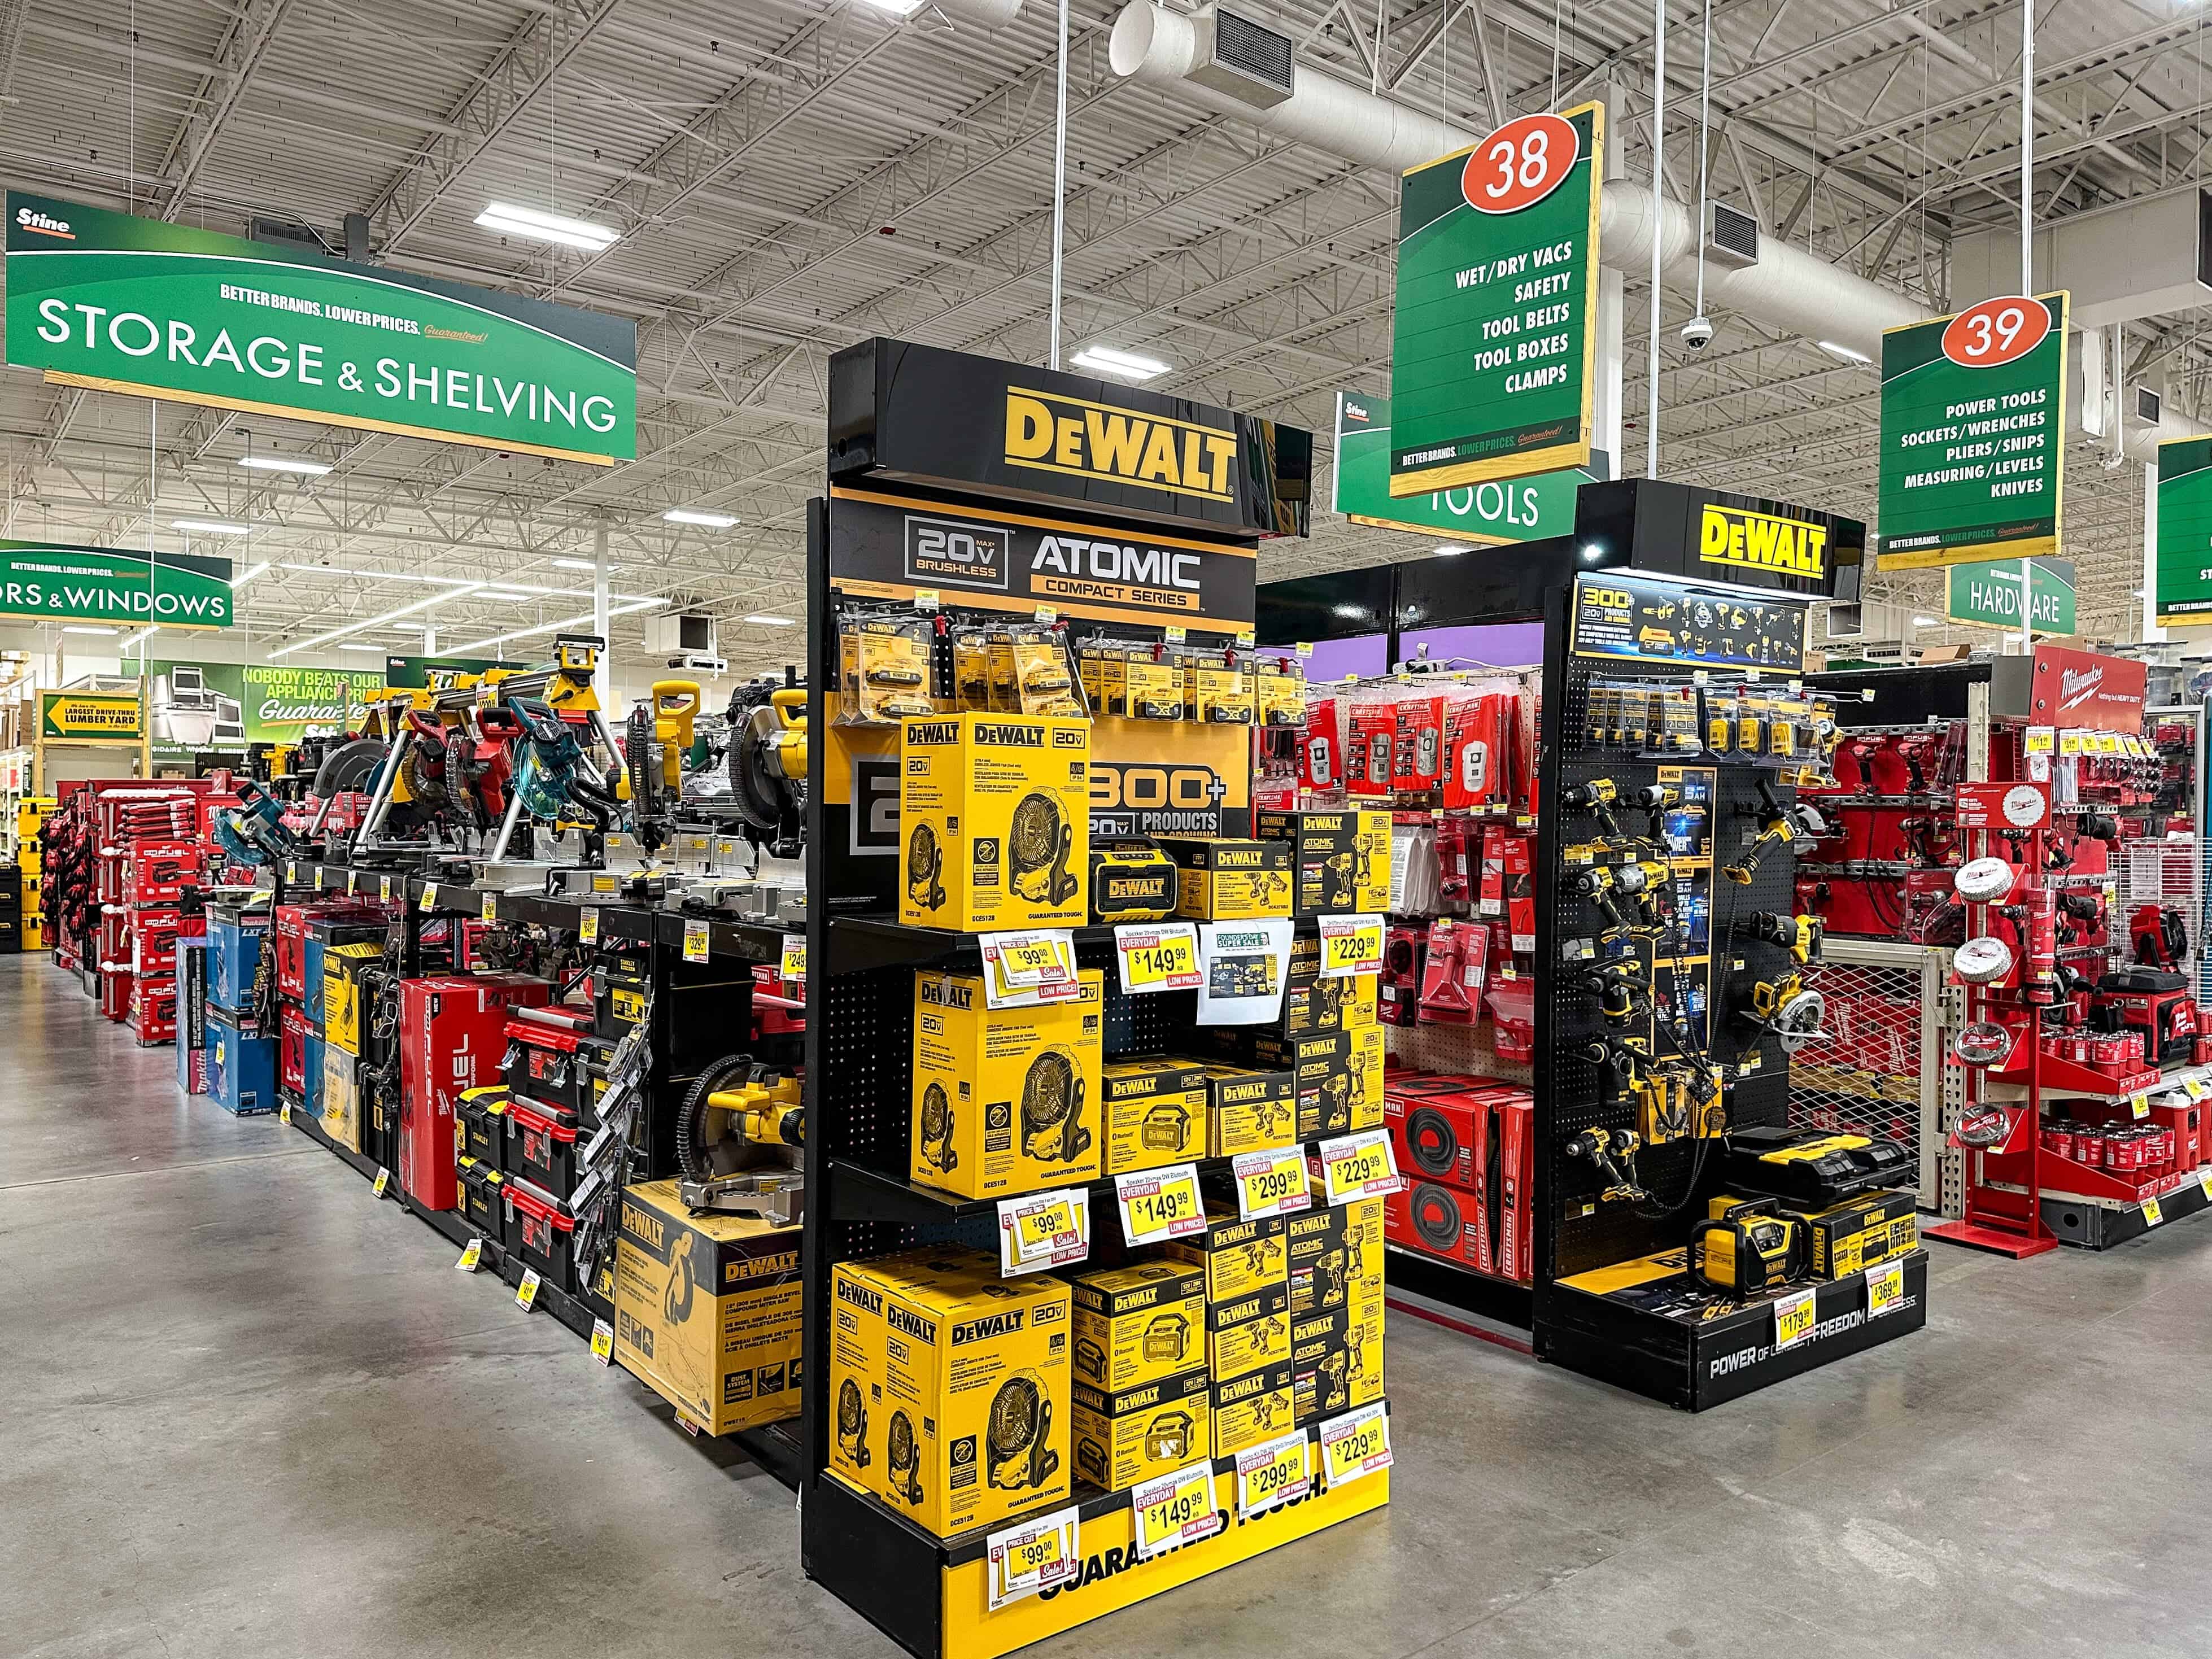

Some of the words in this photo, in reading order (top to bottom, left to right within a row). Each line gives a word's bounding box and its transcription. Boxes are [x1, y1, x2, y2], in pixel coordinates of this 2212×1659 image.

[1485, 129, 1549, 198] 38
[16, 207, 71, 233] Stine
[1456, 251, 1529, 289] WET/DRY
[1533, 241, 1572, 267] VACS
[1515, 272, 1571, 303] SAFETY
[1482, 317, 1521, 340] TOOL
[1525, 303, 1570, 329] BELTS
[1965, 308, 2024, 356] 39
[1473, 348, 1513, 371] TOOL
[1516, 334, 1569, 361] BOXES
[37, 298, 324, 387] STORAGE
[338, 363, 364, 392] &
[374, 357, 617, 433] SHELVING
[1505, 364, 1567, 394] CLAMPS
[1345, 401, 1368, 417] Stine
[1945, 399, 1996, 420] POWER
[2001, 389, 2046, 411] TOOLS
[1901, 412, 2045, 448] SOCKETS/WRENCHES
[1946, 434, 2044, 461] PLIERS/SNIPS
[1904, 456, 2044, 488] MEASURING/LEVELS
[1991, 478, 2043, 498] KNIVES
[917, 560, 997, 577] BRUSHLESS
[1031, 536, 1201, 588] ATOMIC
[0, 582, 42, 606] RS
[49, 593, 63, 608] &
[63, 586, 225, 617] WINDOWS
[1045, 579, 1126, 600] COMPACT
[1132, 588, 1187, 606] SERIES
[1604, 608, 1630, 617] PRODUCTS
[1174, 655, 1181, 663] 5
[243, 669, 302, 686] NOBODY
[305, 672, 350, 686] BEATS
[353, 674, 380, 688] OUR
[2061, 664, 2104, 700] Milwaukee
[266, 684, 337, 700] APPLIANC
[1142, 813, 1217, 830] PRODUCTS
[1324, 927, 1354, 936] EVERYDAY
[1120, 937, 1158, 948] EVERYDAY
[1044, 967, 1063, 977] Sale!
[1168, 976, 1184, 985] LOW
[1185, 974, 1202, 983] PRICE!
[1040, 986, 1055, 995] LOW
[1057, 984, 1077, 993] PRICE!
[1300, 1062, 1329, 1072] ATOMIC
[1325, 1148, 1355, 1161] EVERYDAY
[1041, 1168, 1076, 1178] GUARANTEED
[1238, 1163, 1271, 1176] EVERYDAY
[1122, 1184, 1159, 1198] EVERYDAY
[1171, 1223, 1184, 1233] LOW
[1184, 1219, 1204, 1230] PRICE!
[1057, 1233, 1076, 1245] Sale!
[763, 1294, 783, 1302] SINGLE
[1711, 1346, 1756, 1379] POWER
[1758, 1346, 1769, 1361] OF
[1814, 1308, 1865, 1342] FREEDOM
[727, 1379, 750, 1389] SYSTEM
[1324, 1425, 1355, 1443] EVERYDAY
[1241, 1454, 1274, 1473] EVERYDAY
[1008, 1492, 1044, 1509] GUARANTEED
[1137, 1487, 1175, 1508] EVERYDAY
[1008, 1538, 1023, 1548] PRICE
[1042, 1561, 1063, 1577] Sale!
